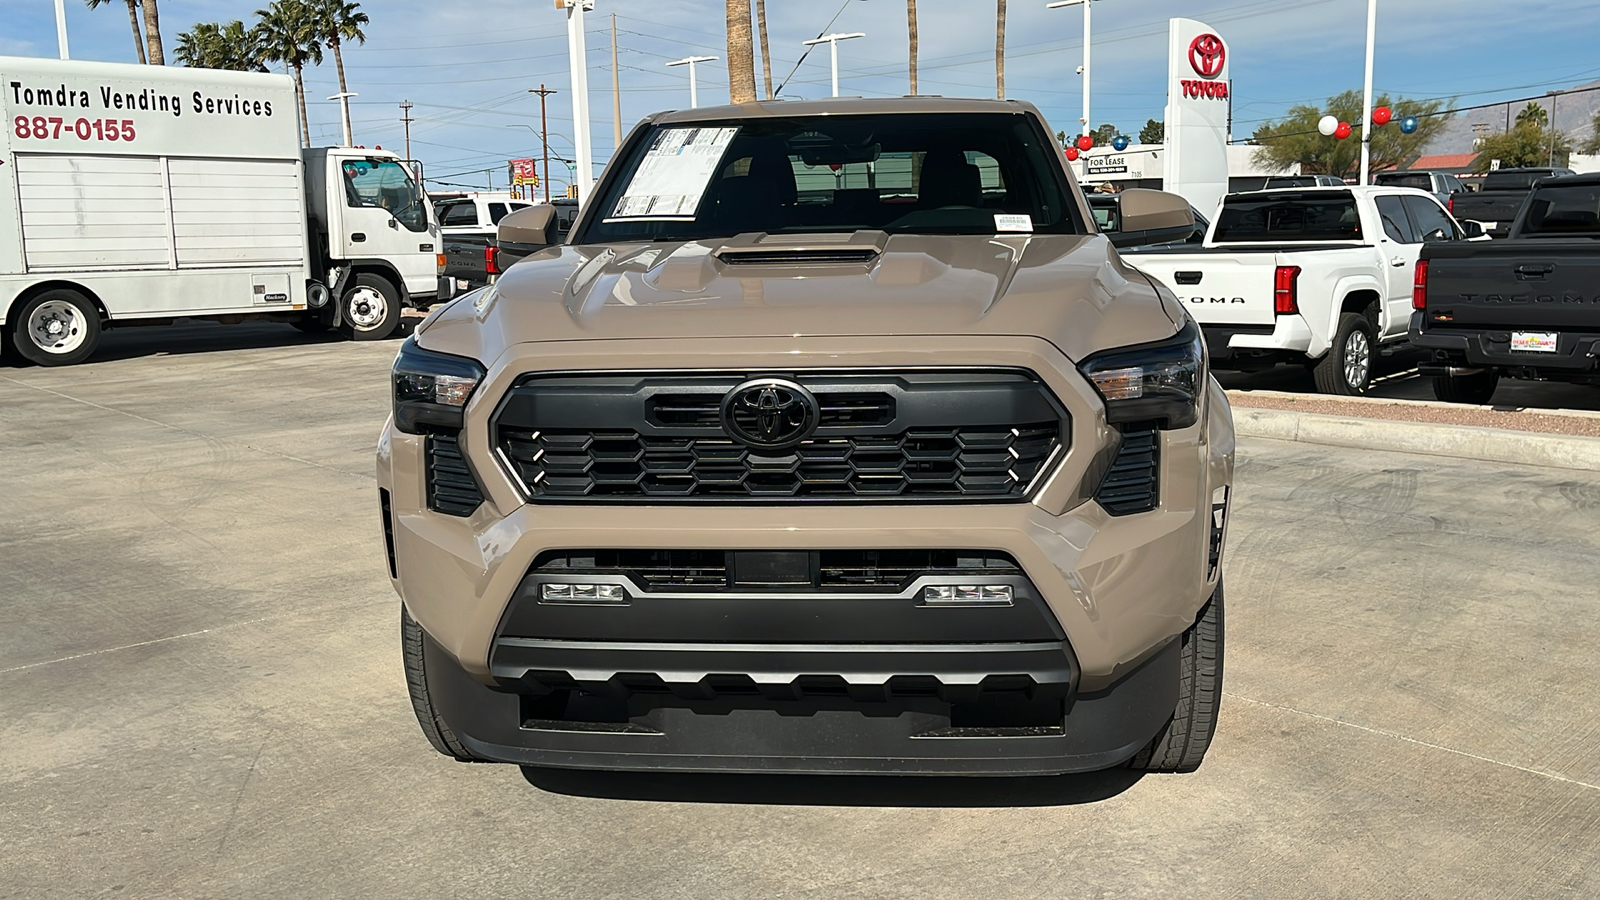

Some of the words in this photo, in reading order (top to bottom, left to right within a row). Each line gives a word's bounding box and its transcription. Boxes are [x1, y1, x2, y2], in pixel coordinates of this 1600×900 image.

[10, 81, 90, 108] Tomdra
[100, 86, 181, 116] Vending
[193, 91, 273, 116] Services
[1181, 80, 1228, 98] TOYOTA
[14, 115, 137, 142] 887-0155
